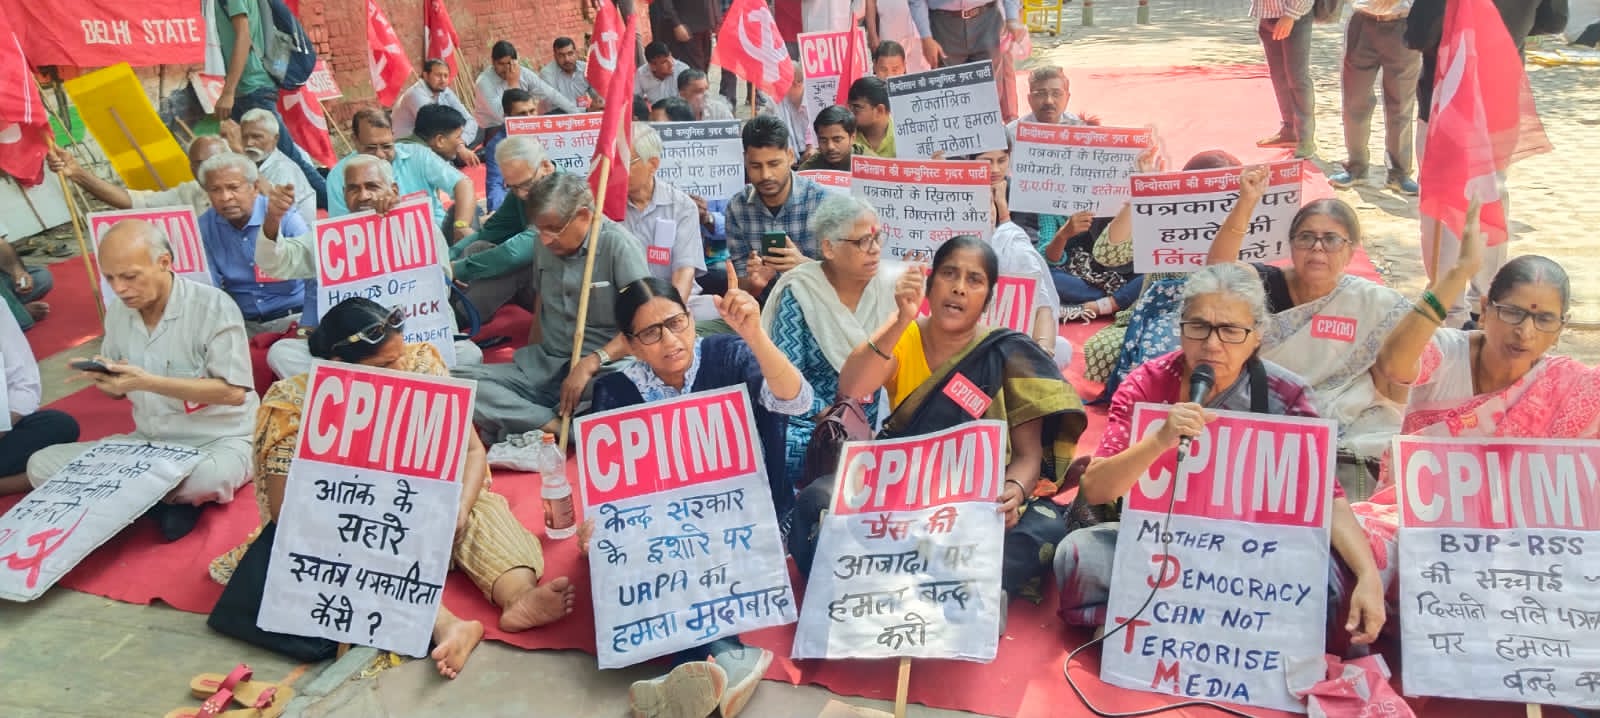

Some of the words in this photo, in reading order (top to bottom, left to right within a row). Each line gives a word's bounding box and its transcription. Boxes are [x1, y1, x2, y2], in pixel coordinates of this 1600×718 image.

[81, 20, 130, 44] DELHI
[143, 18, 200, 44] STATE
[910, 90, 971, 113] लोकतांत्रिक
[897, 114, 940, 136] अधिकारों
[942, 116, 960, 130] पर
[963, 111, 999, 130] हमला
[916, 136, 934, 156] नहीं
[1029, 146, 1072, 160] पत्रकारों
[1077, 147, 1090, 161] के
[688, 165, 705, 177] पर
[1134, 176, 1181, 192] हिन्दोस्तान
[1186, 175, 1199, 190] की
[1280, 165, 1300, 179] पार्टी
[863, 184, 904, 199] पत्रकारों
[909, 185, 921, 199] के
[1072, 183, 1088, 195] का
[1261, 190, 1301, 206] पर
[962, 207, 989, 223] और
[320, 209, 433, 281] CPI(M)
[908, 229, 925, 240] का
[1152, 247, 1209, 267] निंद
[387, 279, 416, 296] OFF
[1317, 318, 1355, 339] CPI(M)
[950, 379, 987, 414] CPI(M)
[307, 376, 461, 480] CPI(M)
[585, 399, 749, 493] CPI(M)
[842, 430, 993, 509] CPI(M)
[1137, 417, 1320, 523] CPI(M)
[314, 475, 376, 506] आतंक
[1405, 449, 1599, 528] CPI(M)
[666, 488, 744, 522] सरकार
[923, 506, 959, 534] की
[337, 512, 410, 556] सहारे
[598, 540, 628, 566] के
[647, 524, 711, 564] इशारे
[723, 524, 757, 550] पर
[1136, 519, 1225, 552] MOTHER
[1241, 538, 1279, 558] OF
[288, 552, 353, 588] स्वतंत्र
[355, 560, 443, 605] पत्रकारिता
[699, 563, 730, 589] का
[1146, 554, 1311, 606] DEMOCRACY
[1421, 561, 1456, 585] की
[1474, 563, 1563, 593] सच्चाई
[918, 578, 977, 610] बन्द
[1416, 590, 1487, 620] दिखाने
[1500, 596, 1548, 625] वाले
[311, 591, 354, 633] कैसे
[367, 611, 383, 644] ?
[612, 610, 678, 654] हमला
[686, 581, 790, 641] मुर्दाबाद
[876, 611, 931, 650] करो
[1152, 601, 1205, 625] CAN
[1221, 607, 1272, 631] NOT
[1115, 617, 1281, 671] TERRORISE
[1427, 632, 1466, 655] पर
[1496, 633, 1572, 662] हमला
[1151, 659, 1250, 702] MEDIA
[1503, 668, 1557, 698] बन्द
